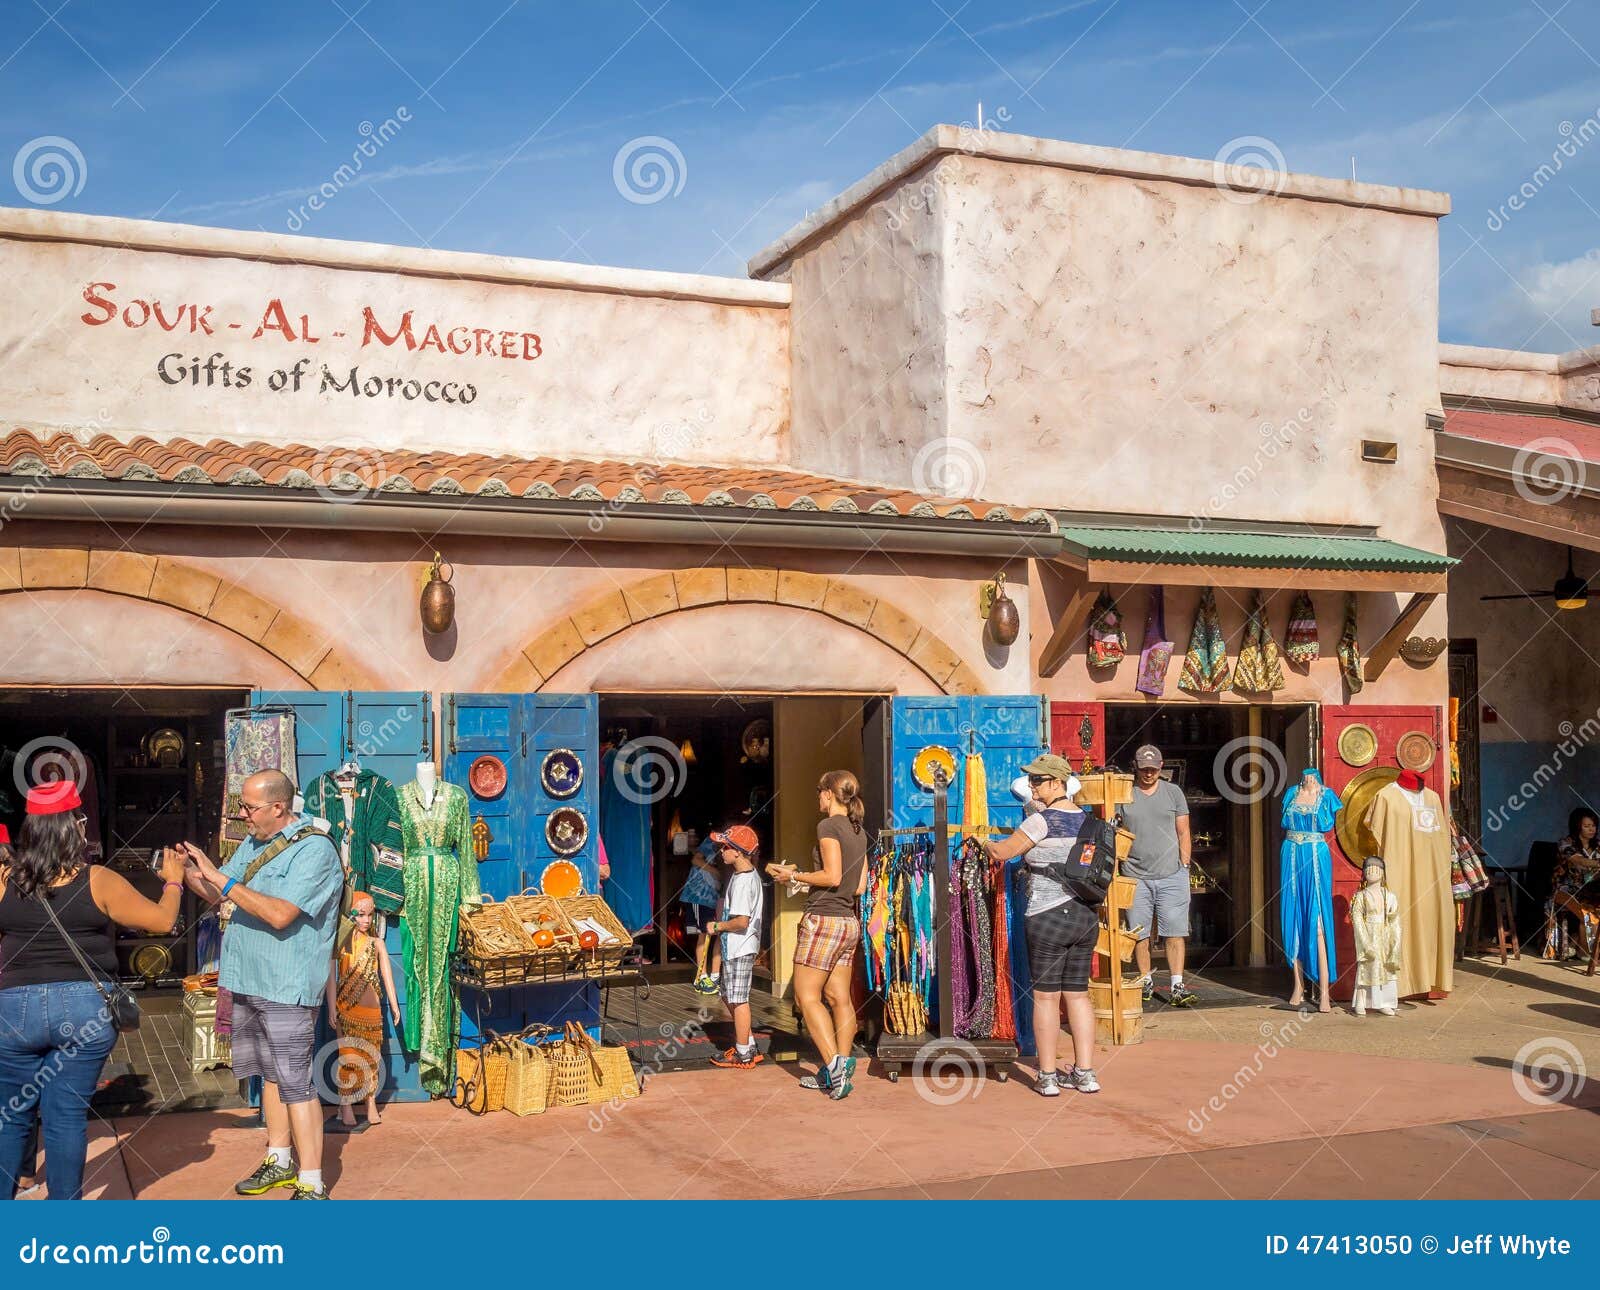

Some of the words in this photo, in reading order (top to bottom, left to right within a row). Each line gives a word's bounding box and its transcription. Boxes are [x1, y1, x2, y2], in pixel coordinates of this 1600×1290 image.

[81, 282, 214, 336] SOUK
[252, 299, 321, 343] AL
[361, 306, 543, 361] MAGREB
[157, 352, 253, 388] Gifts
[268, 358, 311, 393] of
[319, 364, 478, 405] Morocco
